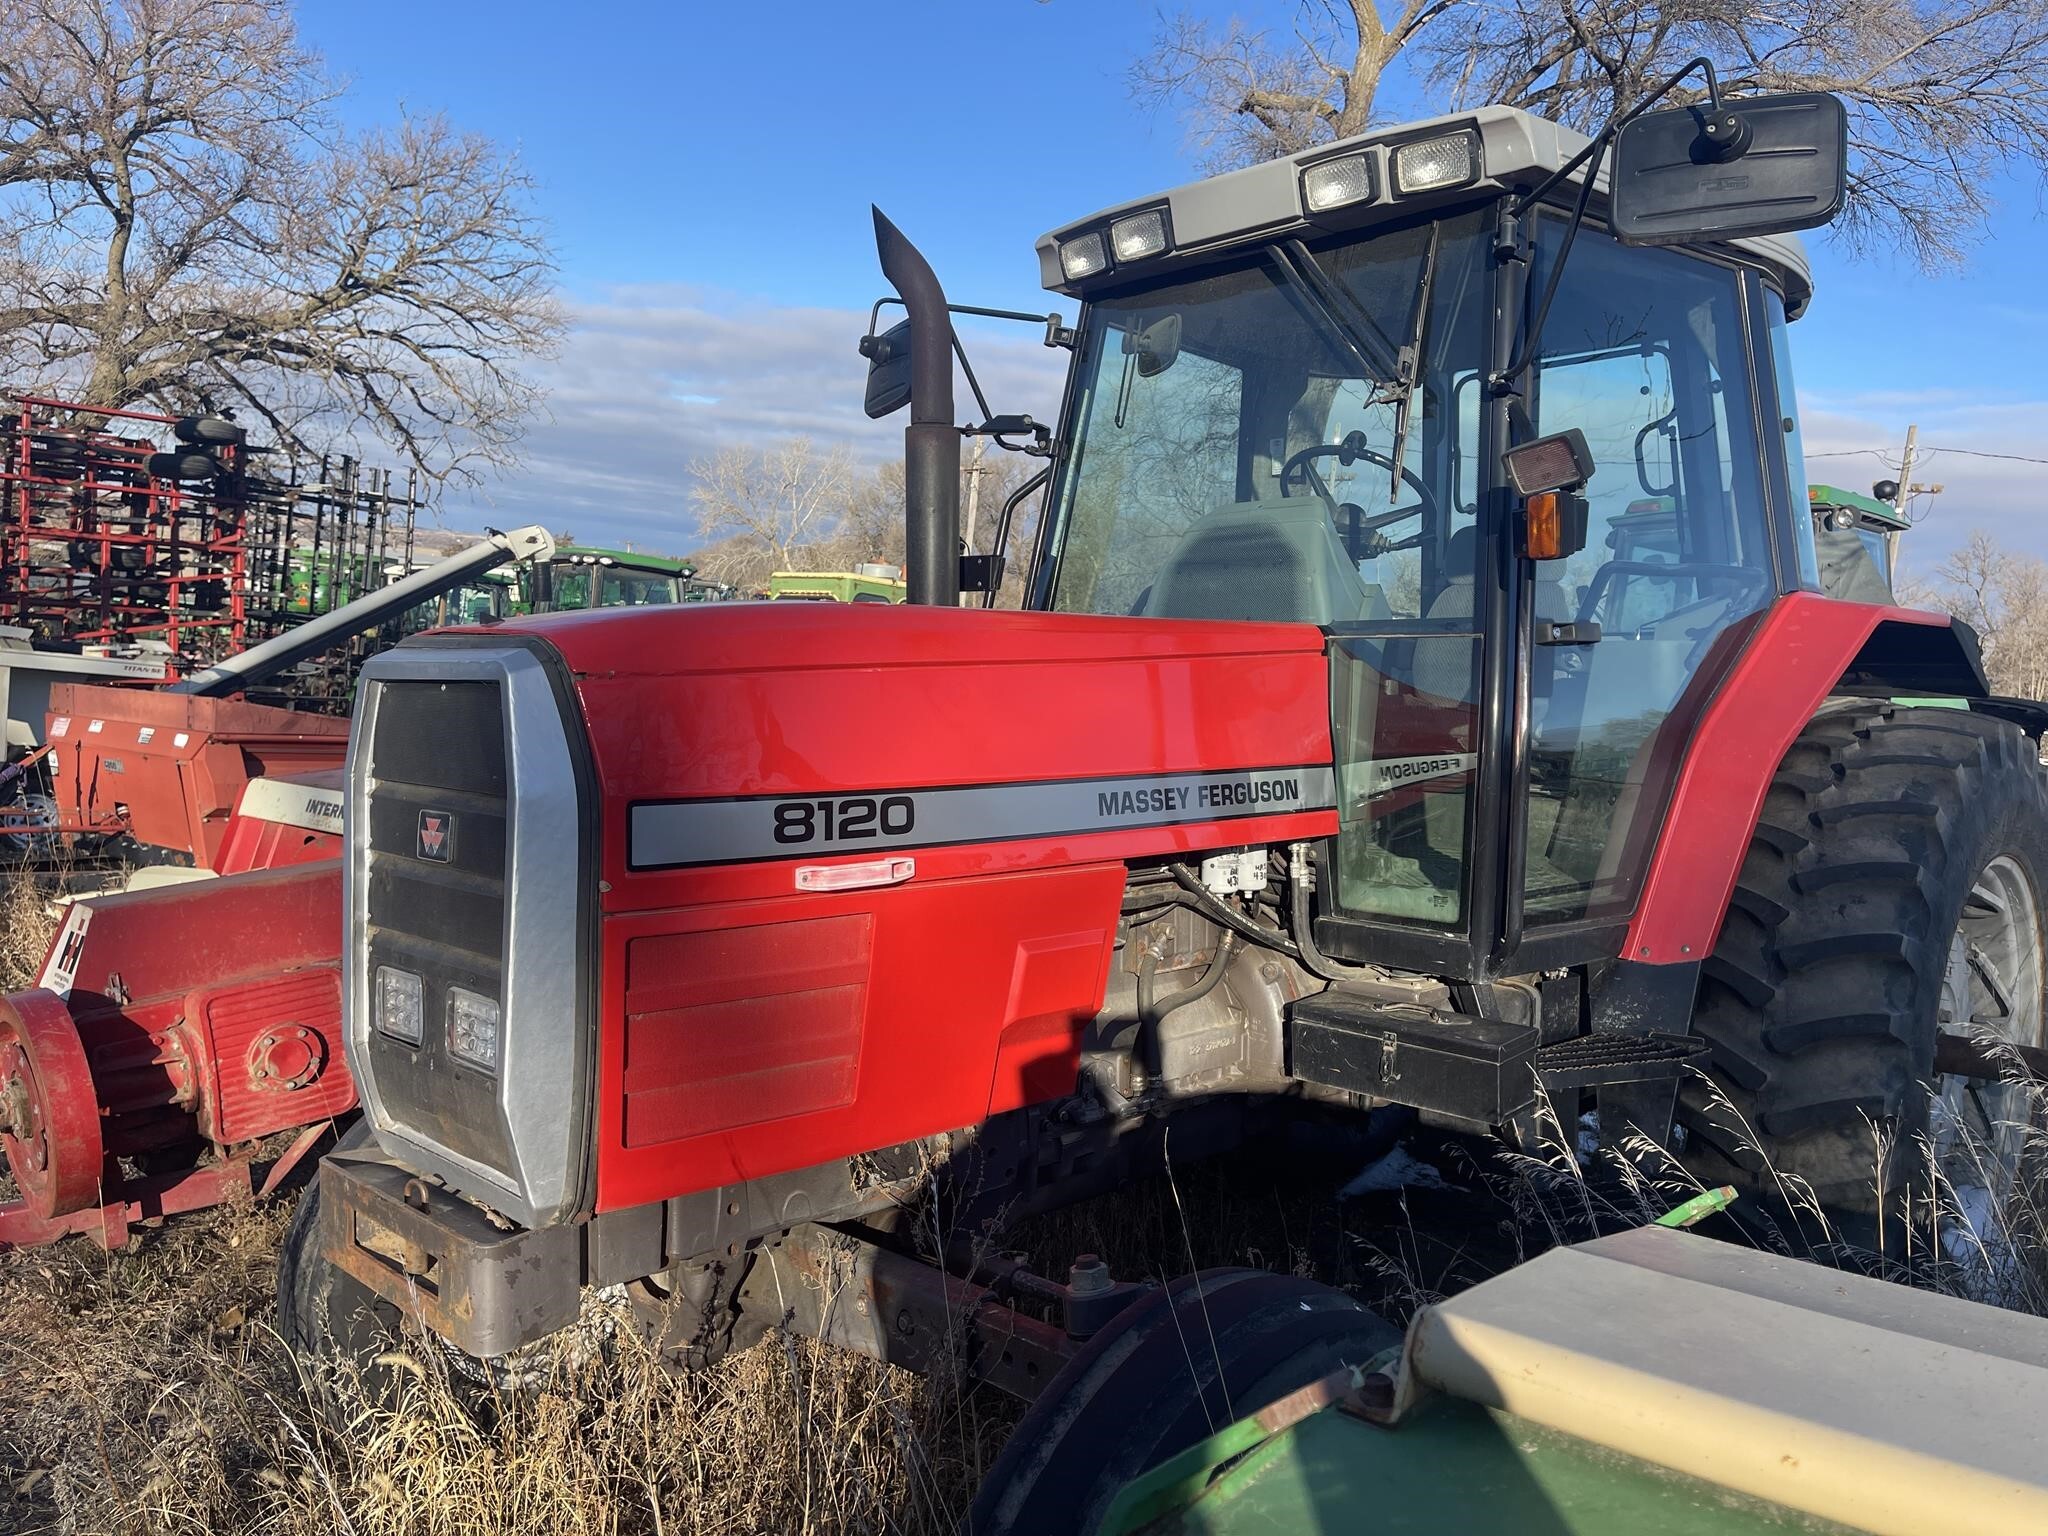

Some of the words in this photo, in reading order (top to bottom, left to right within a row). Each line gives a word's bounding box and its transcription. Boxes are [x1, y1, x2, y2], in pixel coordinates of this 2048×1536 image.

[124, 665, 150, 673] TITAN
[1098, 786, 1190, 817] MASSEY
[1197, 778, 1299, 808] FERGUSON
[773, 796, 915, 844] 8120
